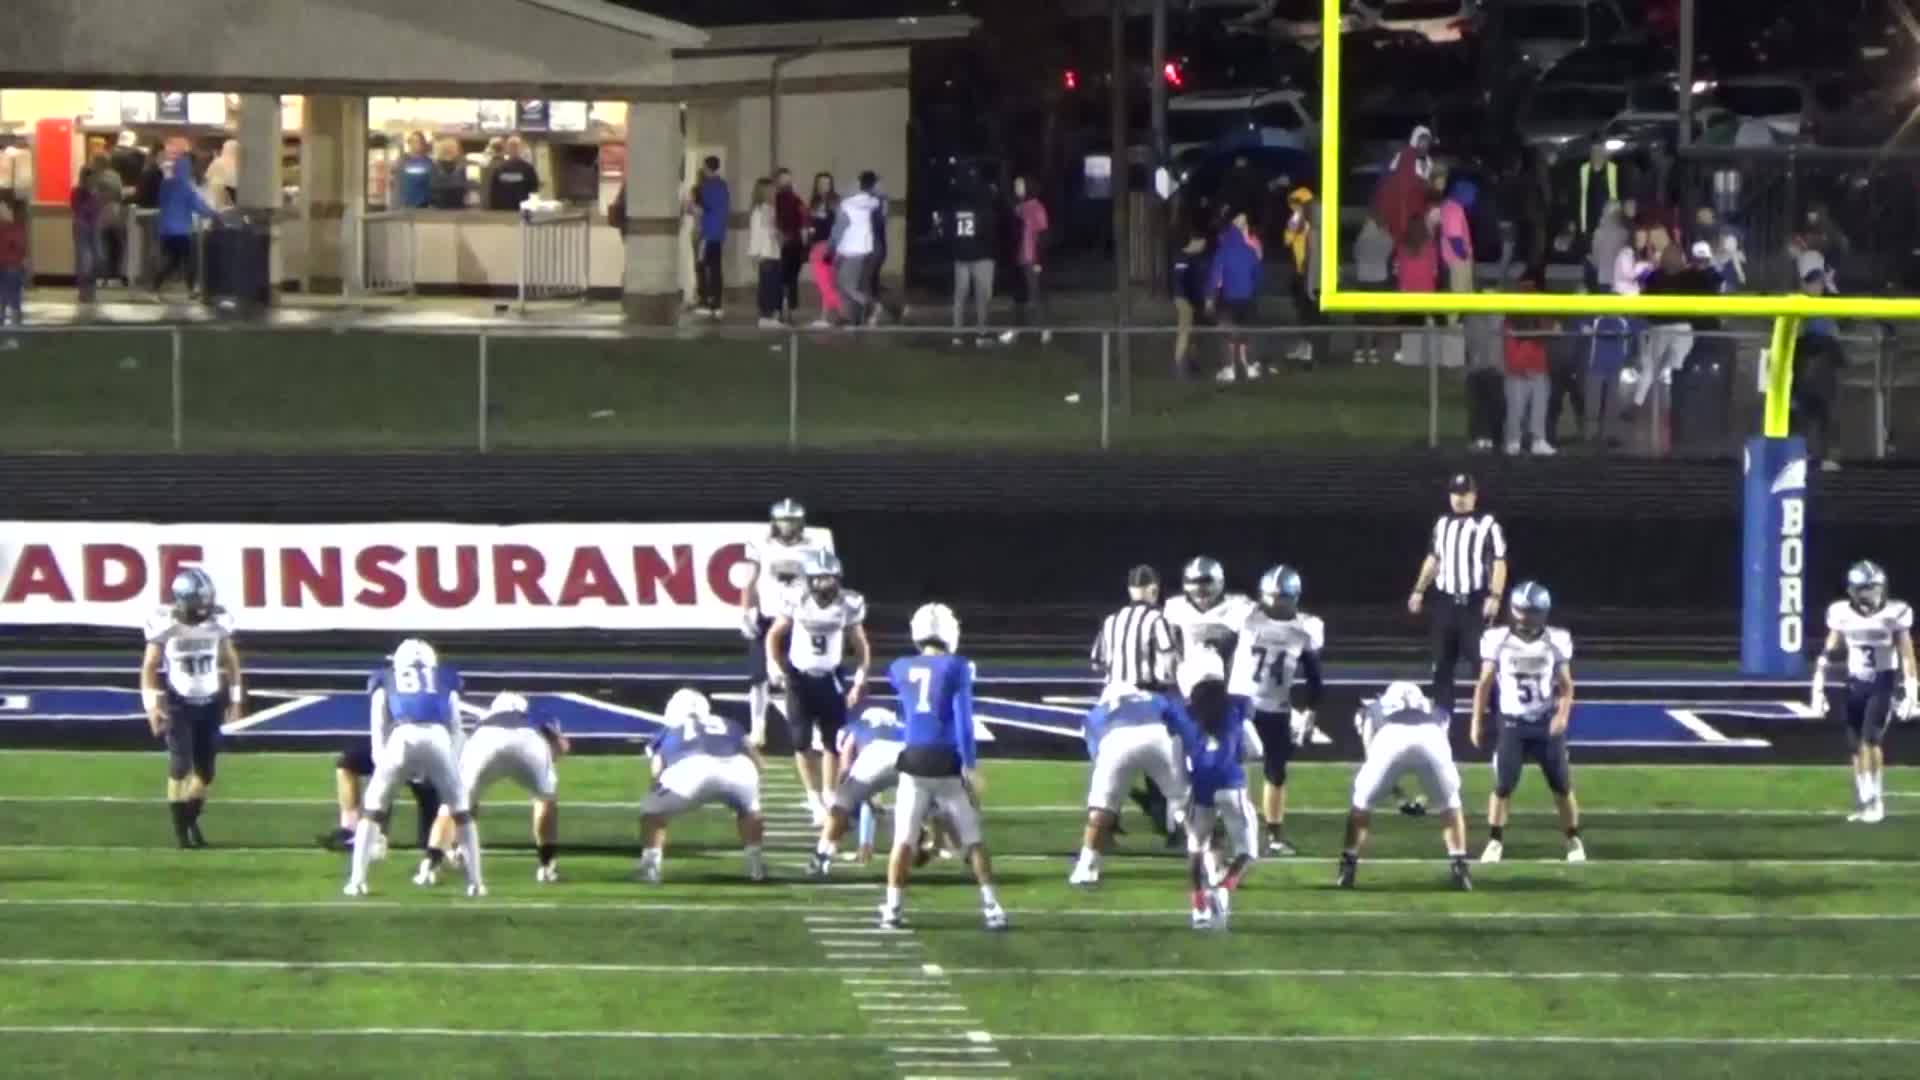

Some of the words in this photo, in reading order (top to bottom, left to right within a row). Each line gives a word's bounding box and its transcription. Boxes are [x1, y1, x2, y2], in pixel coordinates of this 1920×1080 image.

[957, 220, 974, 236] 12
[1780, 498, 1804, 653] BORO
[811, 635, 827, 656] 9
[909, 668, 931, 713] 7
